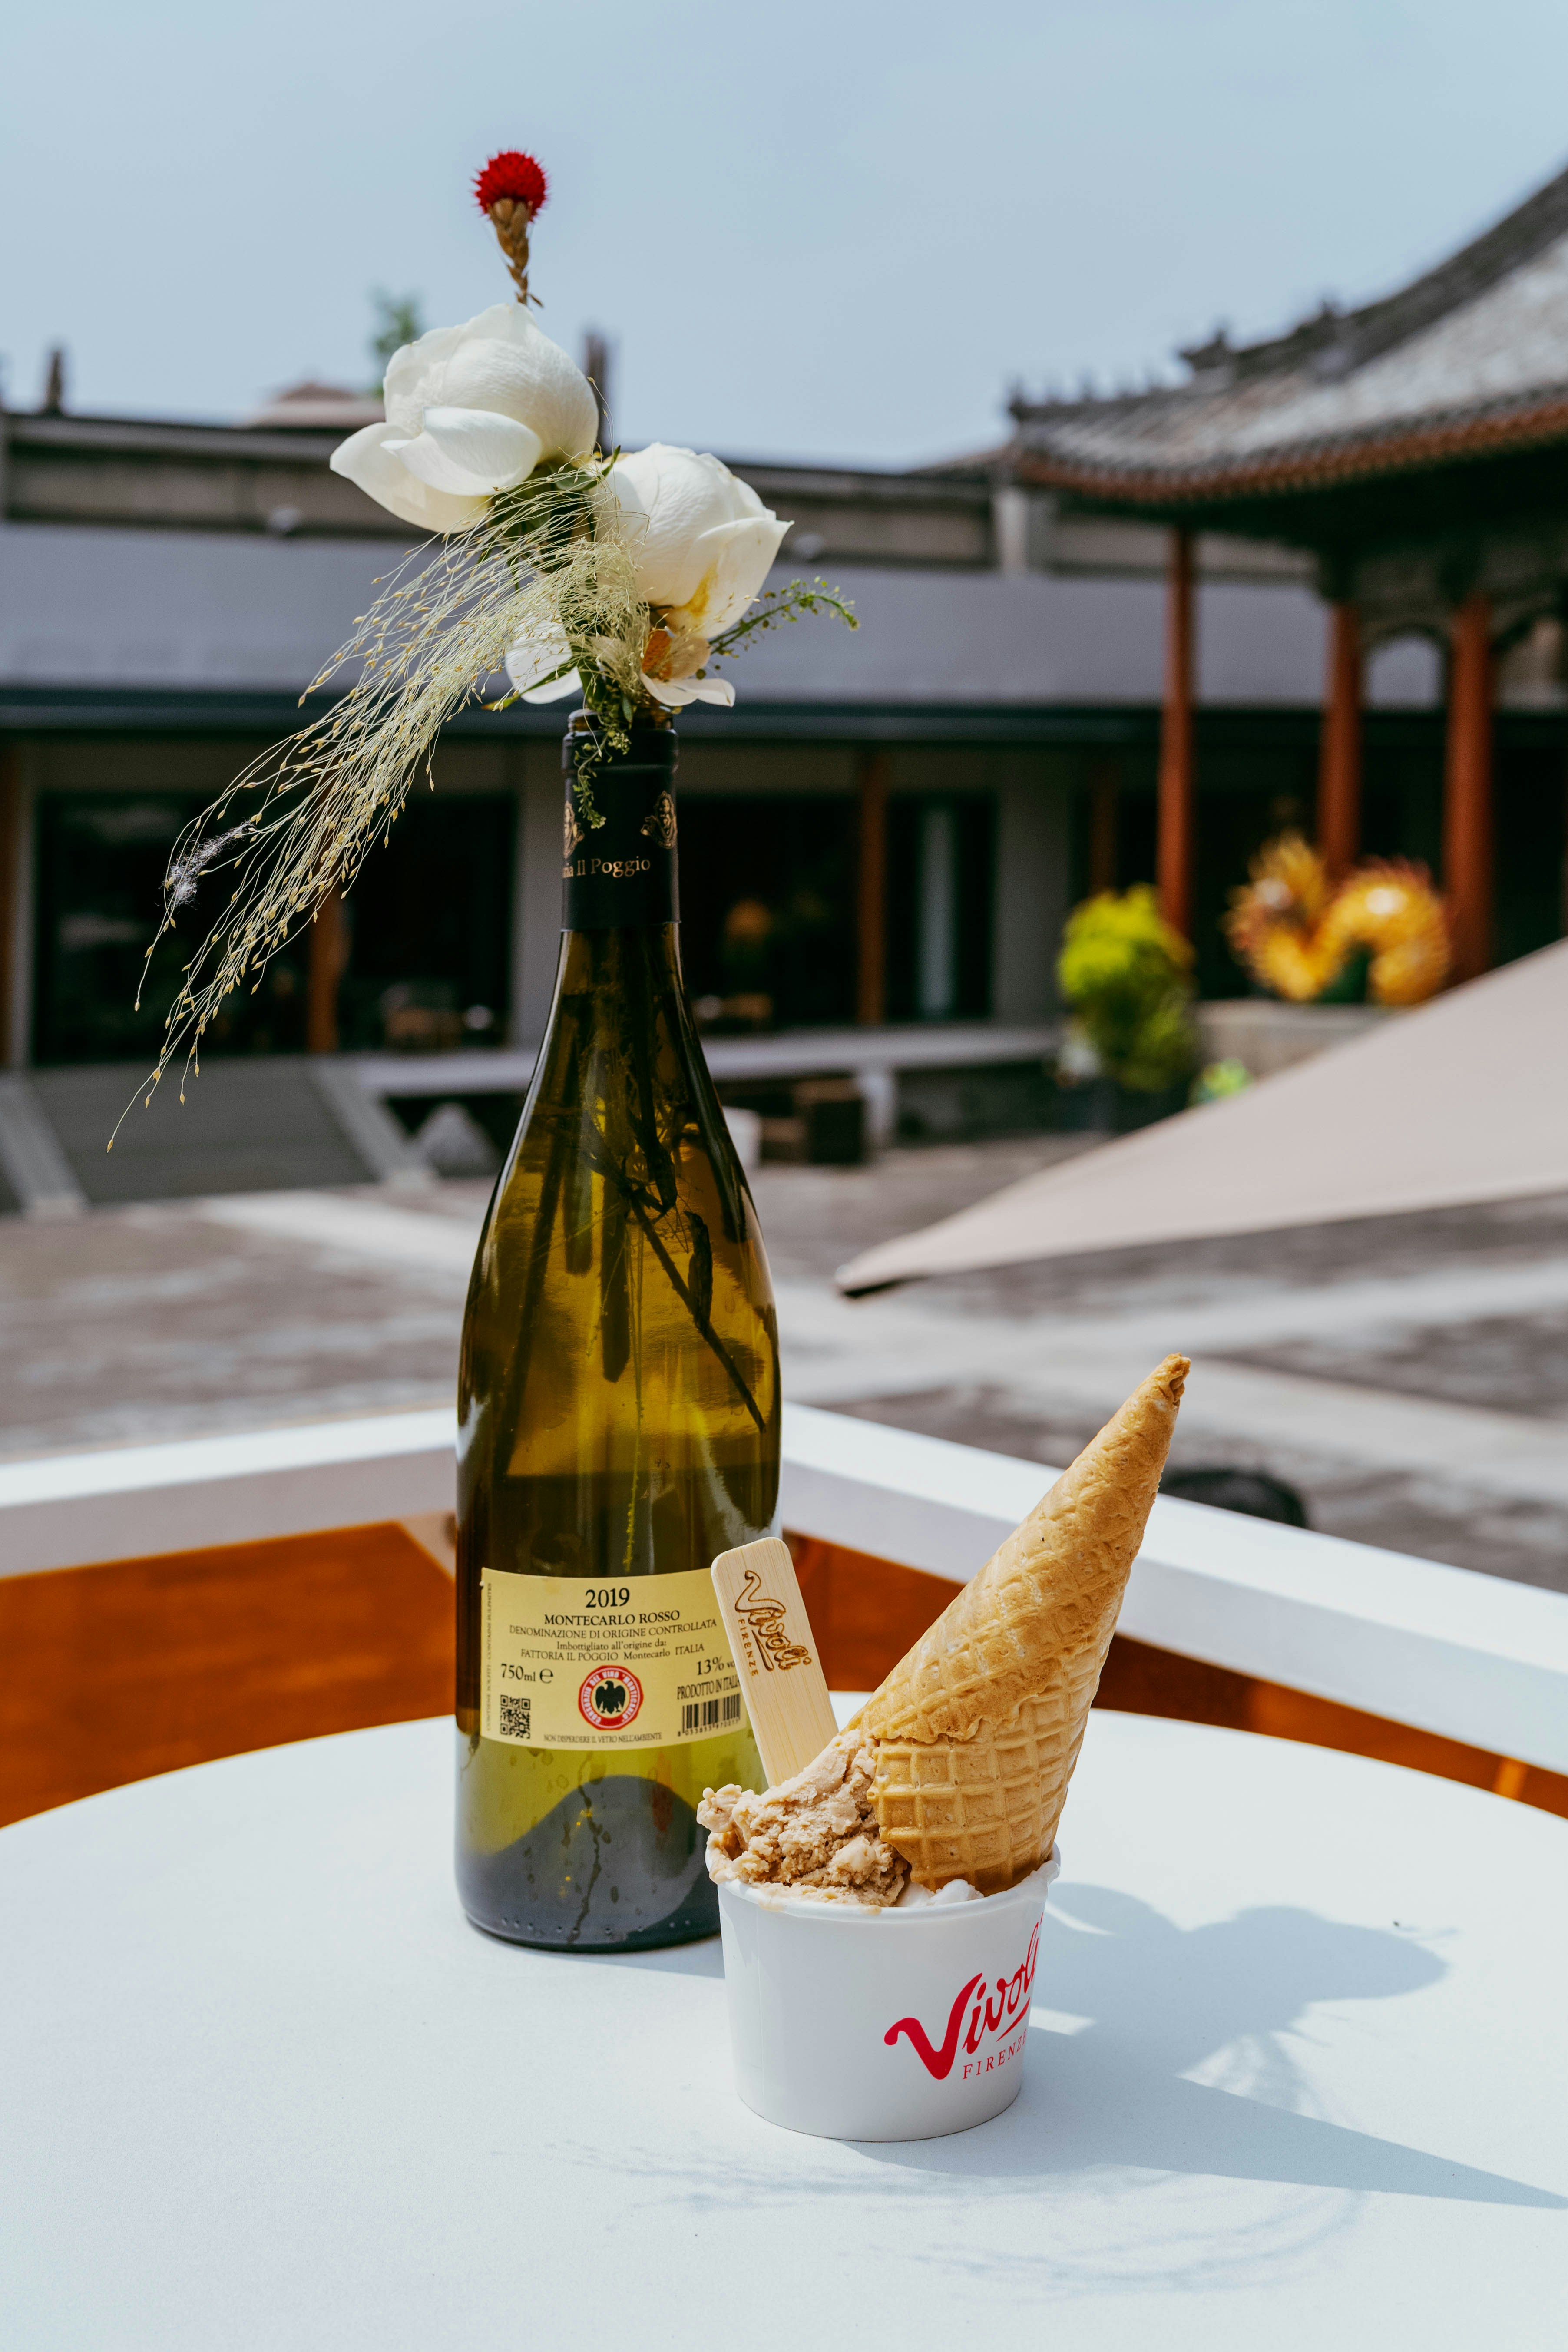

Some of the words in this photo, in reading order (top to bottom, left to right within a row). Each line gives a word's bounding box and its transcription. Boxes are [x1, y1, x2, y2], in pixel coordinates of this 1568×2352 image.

[590, 856, 651, 878] Poggio
[585, 1587, 630, 1608] 2019
[509, 1624, 587, 1638] DENOMINAZIONE
[589, 1630, 600, 1638] DI
[602, 1628, 646, 1638] ORIGINE
[648, 1618, 717, 1636] CONTROLLATA
[544, 1614, 635, 1626] MONTECARLO
[639, 1610, 680, 1624] ROSSO
[521, 1648, 564, 1661] FATTORIA
[567, 1652, 576, 1661] IL
[578, 1652, 619, 1661] POGGIO
[623, 1648, 671, 1661] Montecarlo
[675, 1643, 705, 1655] ITALIA
[557, 1641, 609, 1651] Imbottigliato
[611, 1640, 652, 1651] all'origine
[654, 1638, 667, 1647] da:
[737, 1618, 759, 1677] FIRENZE
[602, 1671, 620, 1679] VINO
[697, 1655, 724, 1676] 13%
[677, 1680, 715, 1700] PRODOTTO
[715, 1678, 722, 1693] IN
[543, 1734, 556, 1742] NON
[557, 1734, 590, 1743] DISPERDERE
[962, 2028, 1027, 2080] FIRENZE
